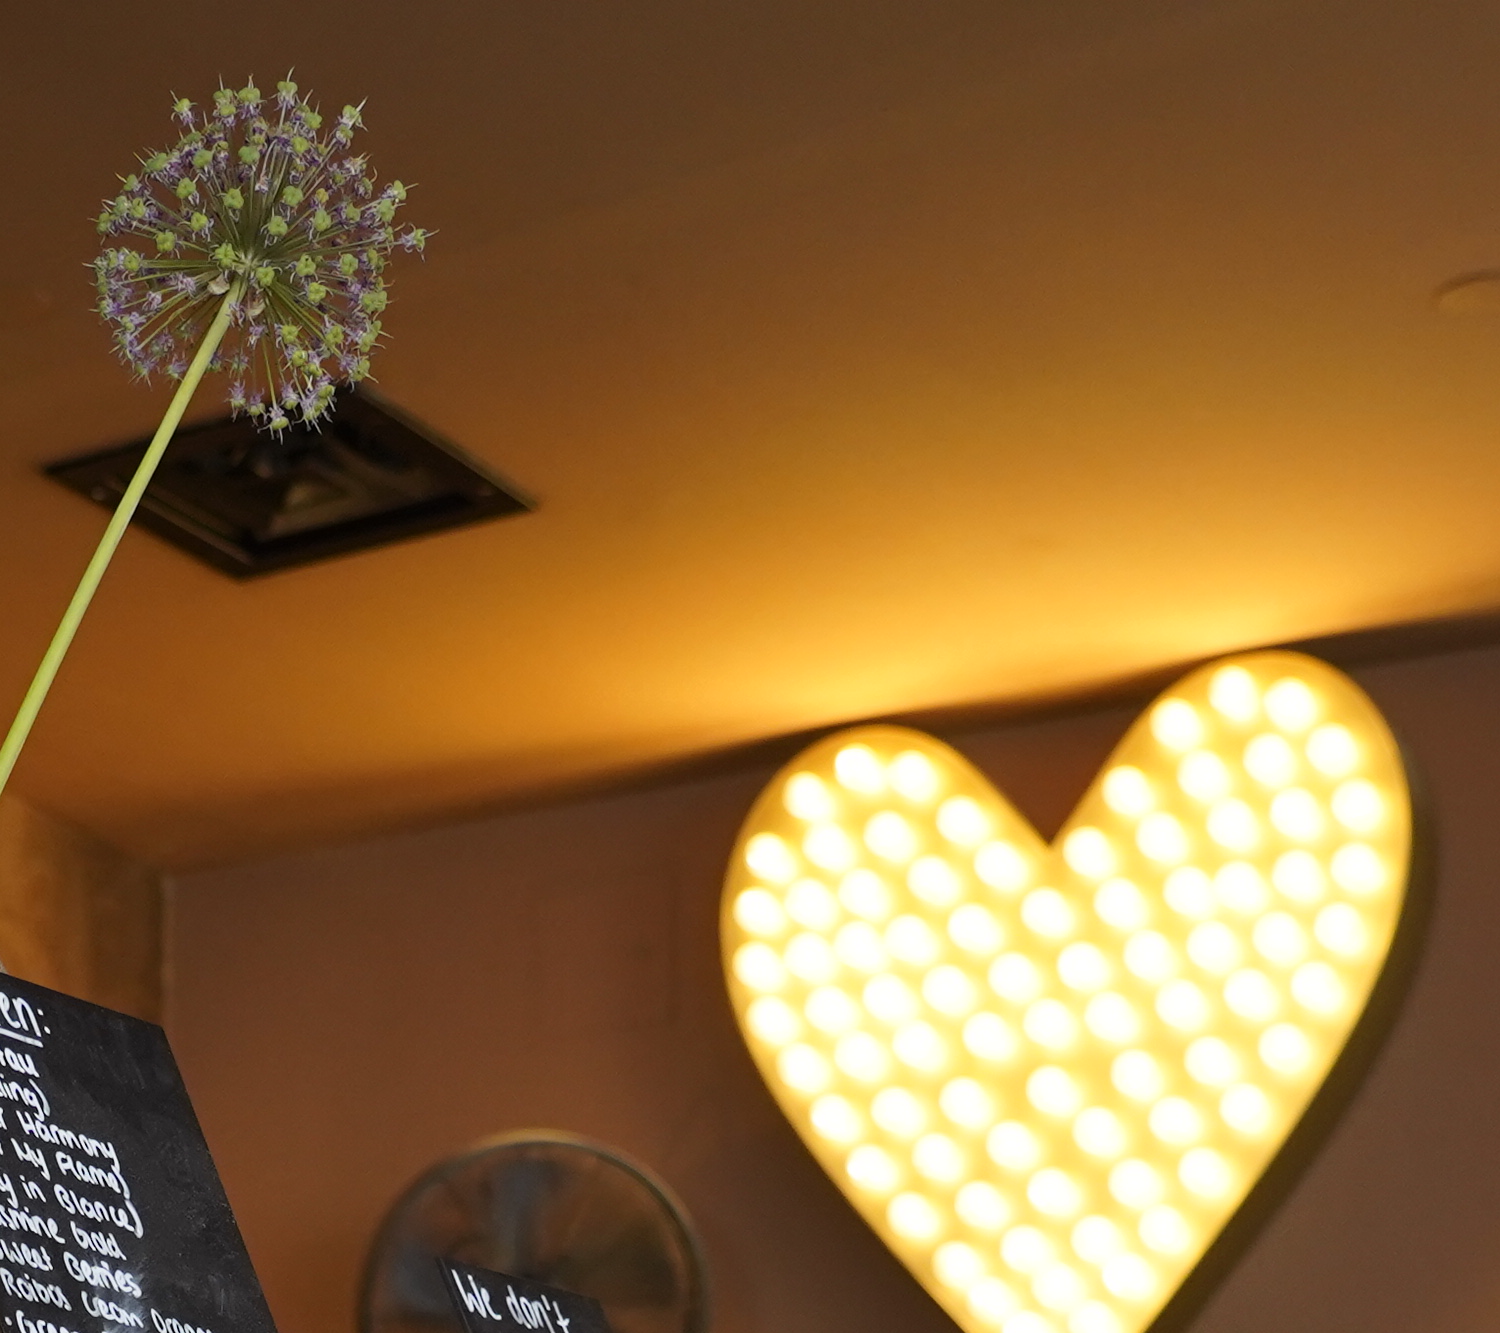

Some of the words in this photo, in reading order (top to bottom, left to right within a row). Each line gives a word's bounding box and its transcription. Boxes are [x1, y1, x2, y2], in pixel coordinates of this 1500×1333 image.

[11, 1138, 51, 1182] My
[16, 1110, 122, 1175] Harmony
[19, 1174, 48, 1203] in
[63, 1251, 144, 1299] Berries
[451, 1269, 503, 1321] We
